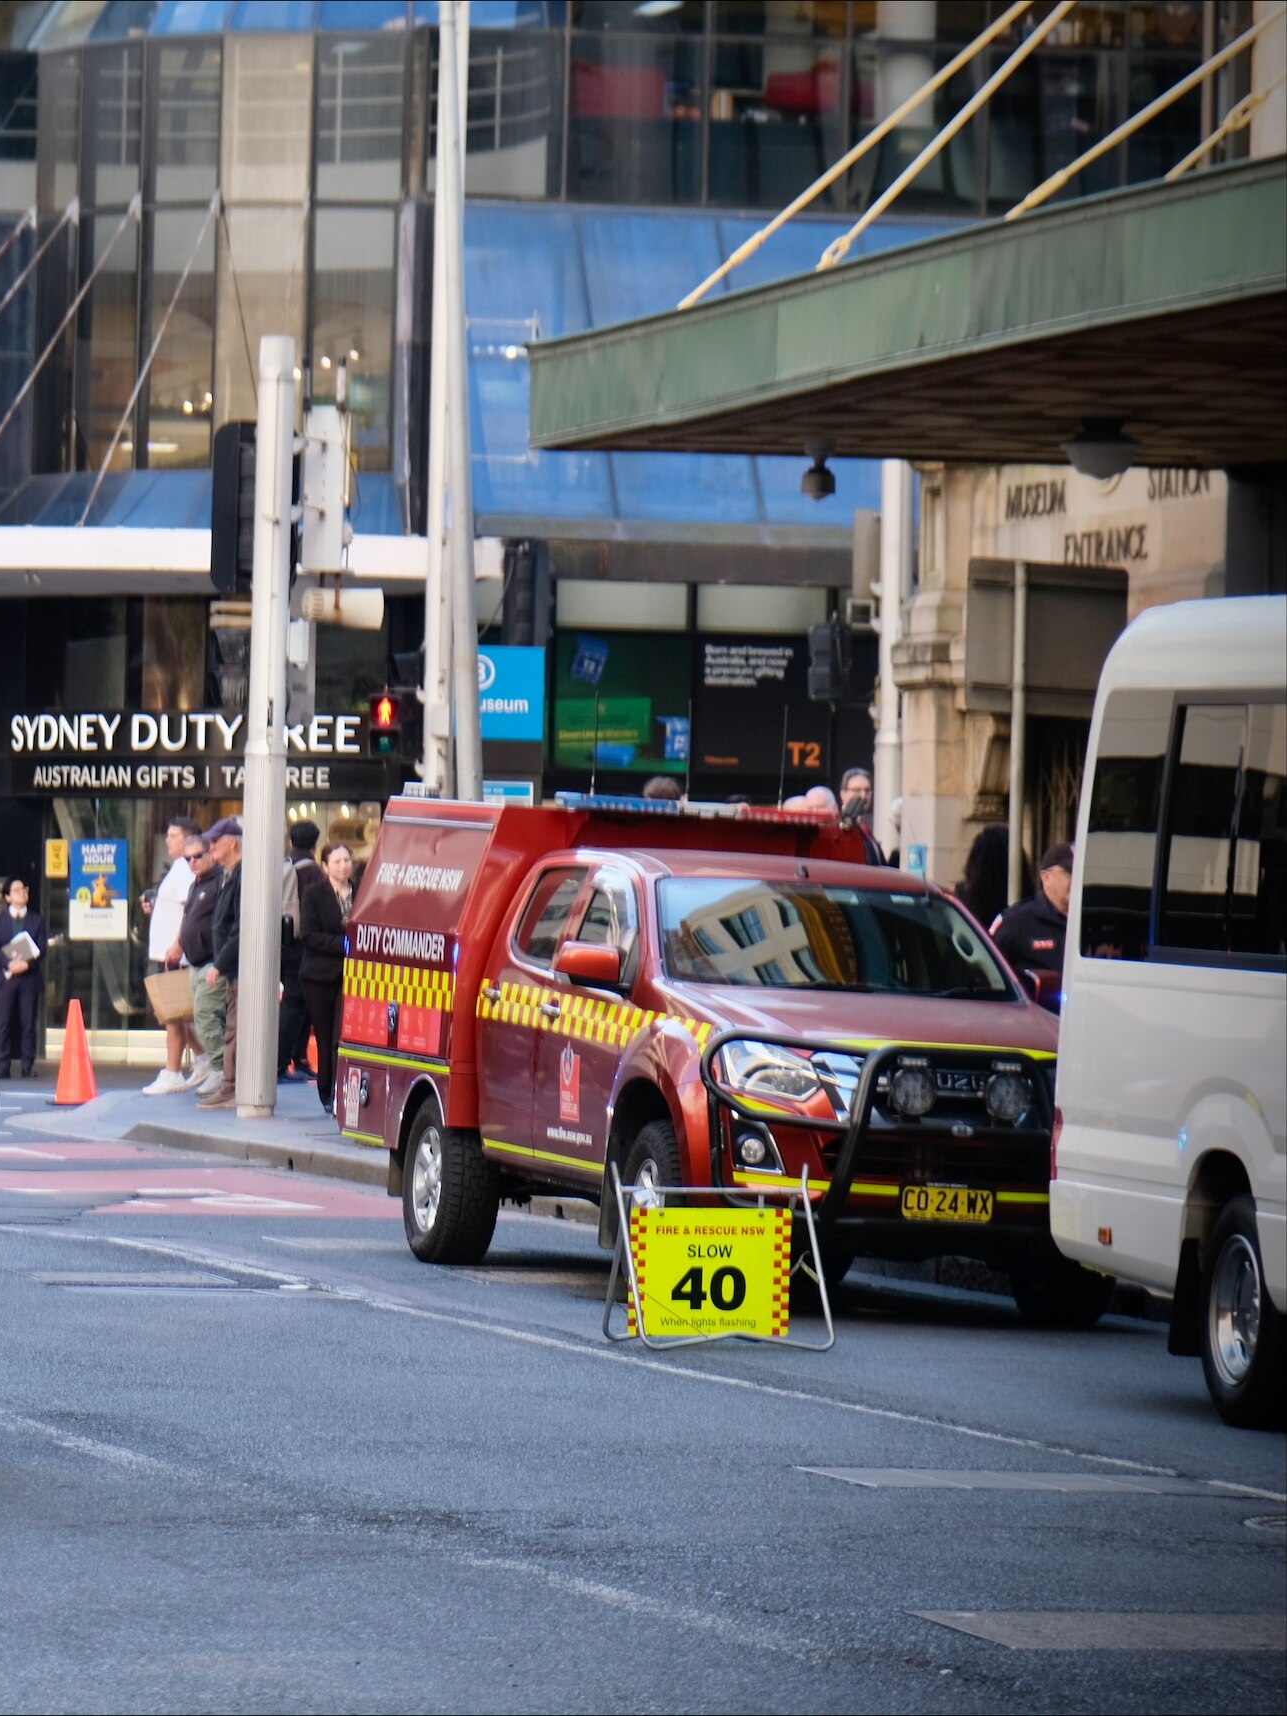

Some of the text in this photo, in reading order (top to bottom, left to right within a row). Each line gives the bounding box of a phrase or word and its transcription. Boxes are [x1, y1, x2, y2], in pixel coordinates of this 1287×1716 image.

[1005, 468, 1211, 520] MUSEUM STATION
[1064, 524, 1149, 569] ENTRANCE
[479, 698, 529, 714] useum
[10, 712, 362, 754] SYDNEY DUTY REE
[787, 741, 821, 767] T2
[33, 765, 132, 789] AUSTRALIAN
[136, 765, 196, 789] GIFTS
[221, 766, 246, 790] TA
[285, 766, 331, 790] REE
[81, 843, 117, 855] HAPPY
[84, 854, 115, 865] HOUR
[376, 862, 399, 885] FIRE
[402, 864, 443, 891] RESCUE
[438, 868, 465, 893] NSW
[356, 923, 446, 963] DUTY COMMANDER
[656, 1226, 766, 1236] FIRE & RESCUE NSW
[687, 1244, 733, 1259] SLOW
[671, 1265, 747, 1312] 40
[660, 1317, 757, 1329] When lights flashing
